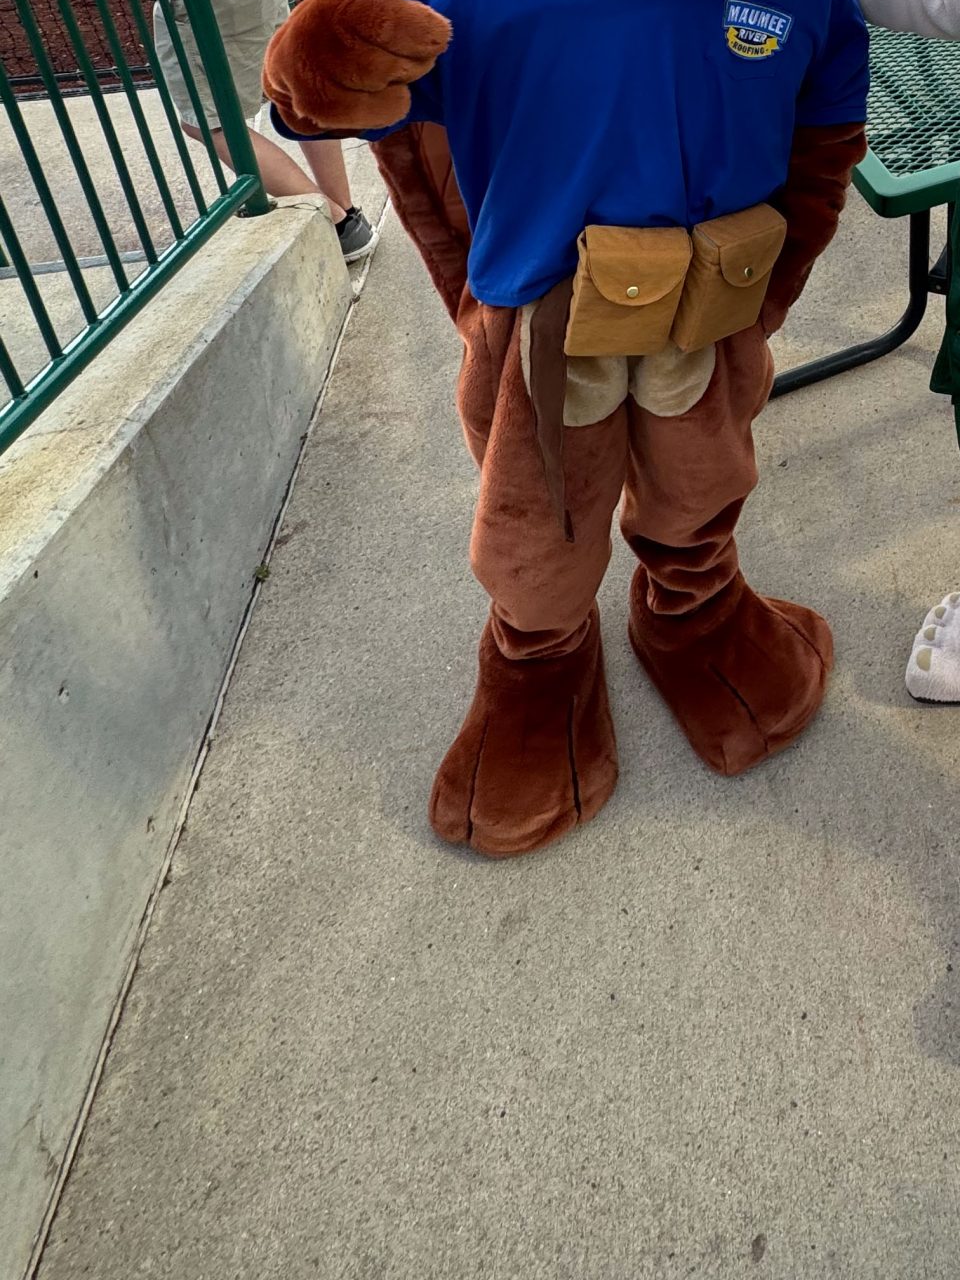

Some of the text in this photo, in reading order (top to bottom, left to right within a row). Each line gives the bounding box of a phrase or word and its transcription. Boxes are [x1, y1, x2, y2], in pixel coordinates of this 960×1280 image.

[727, 4, 788, 35] MAUMEE
[738, 28, 768, 44] RIVER
[732, 41, 766, 56] ROOFING
